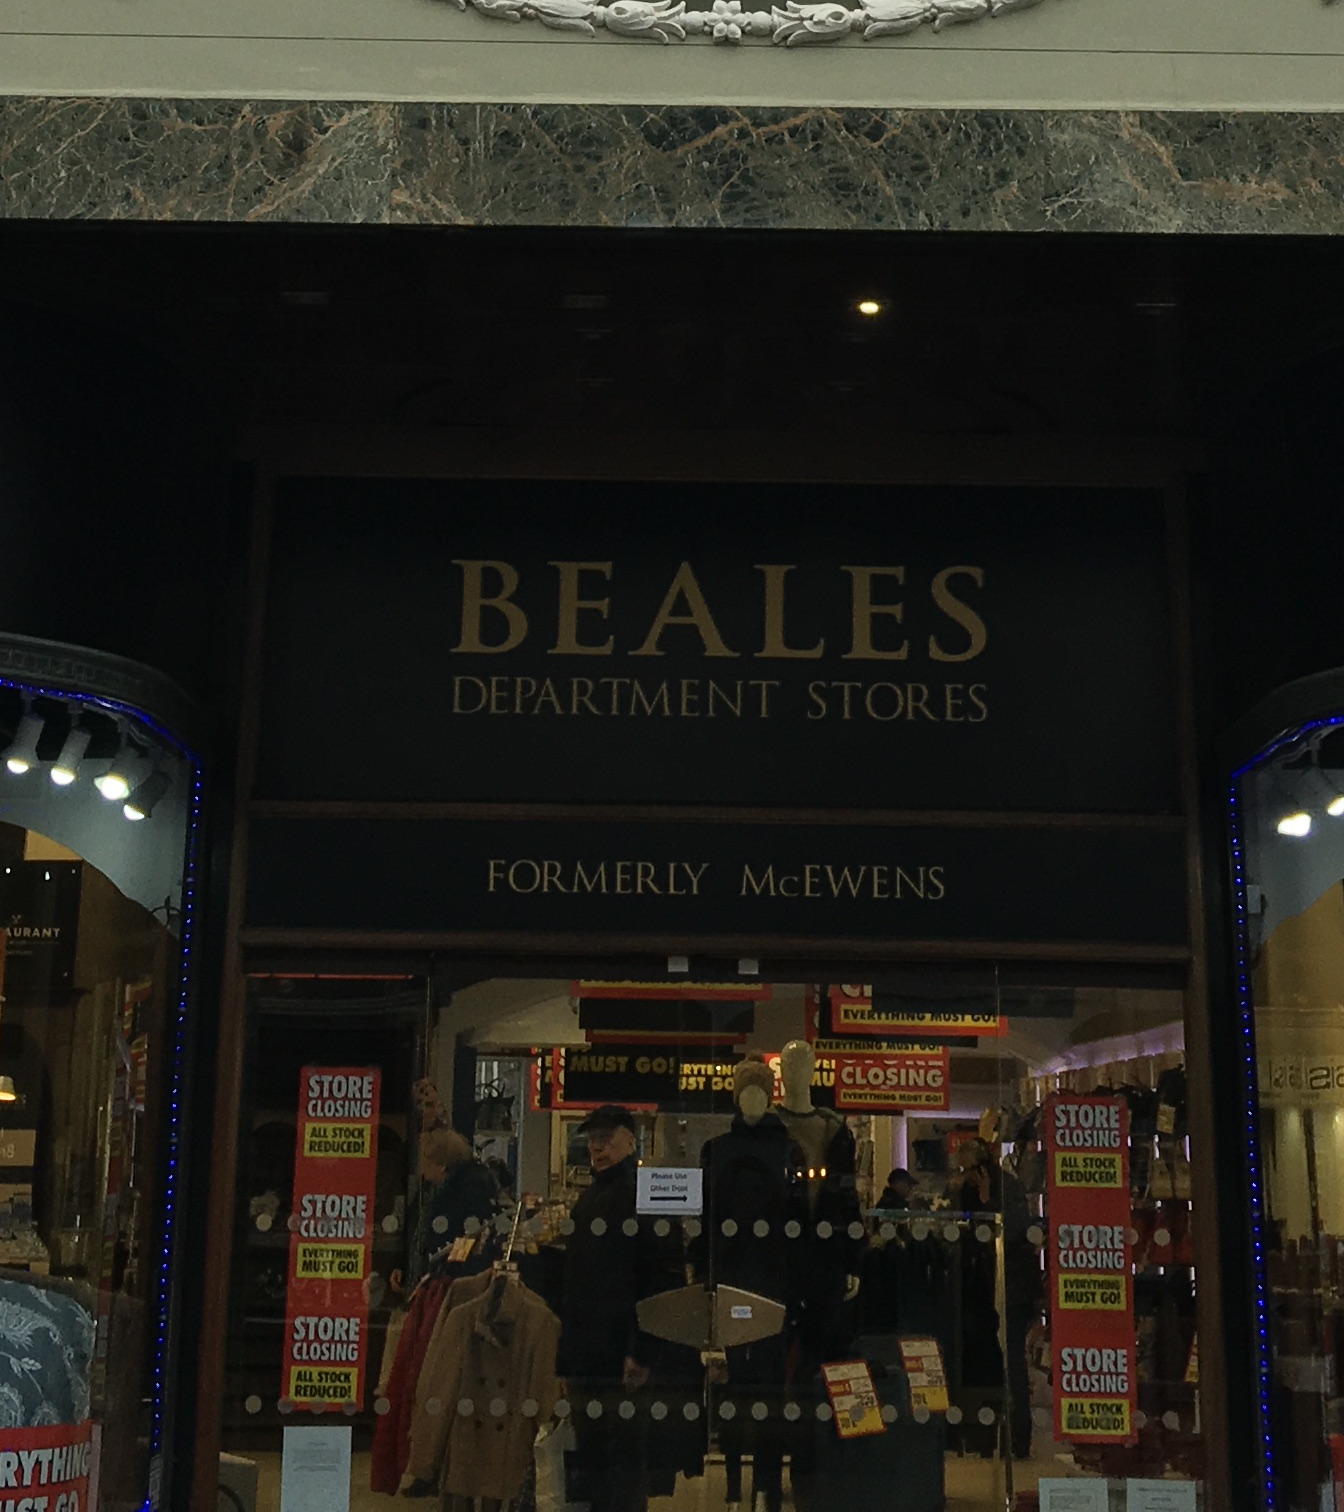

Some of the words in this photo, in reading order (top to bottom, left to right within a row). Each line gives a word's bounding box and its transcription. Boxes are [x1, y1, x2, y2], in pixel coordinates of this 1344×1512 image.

[450, 559, 988, 662] BEALES
[451, 676, 780, 719] DEPARTMENT
[807, 681, 989, 724] STORES
[487, 859, 709, 896] FORMERLY
[740, 865, 947, 900] McEWENS
[814, 1039, 882, 1051] EVERYTHING
[570, 1055, 629, 1074] MUST
[635, 1056, 675, 1075] GO!
[308, 1074, 374, 1100] STORE
[840, 1066, 945, 1088] CLOSING
[307, 1099, 372, 1119] CLOSING
[1055, 1104, 1121, 1129] STORE
[309, 1126, 329, 1139] ALL
[331, 1126, 365, 1139] STOCK
[1055, 1129, 1122, 1148] CLOSING
[309, 1140, 366, 1154] REDUCED!
[1060, 1156, 1080, 1169] ALL
[1082, 1156, 1118, 1170] STOCK
[1060, 1169, 1118, 1184] REDUCED!
[300, 1193, 368, 1219] STORE
[299, 1219, 367, 1239] CLOSING
[1057, 1224, 1126, 1250] STORE
[302, 1247, 360, 1260] EVERYTHING
[1058, 1250, 1126, 1270] CLOSING
[301, 1259, 335, 1273] MUST
[337, 1260, 359, 1274] GO!
[1063, 1278, 1122, 1290] EVERYTHING
[1064, 1290, 1098, 1304] MUST
[1100, 1291, 1122, 1305] GO!
[292, 1315, 361, 1342] STORE
[292, 1342, 360, 1362] CLOSING
[1061, 1347, 1128, 1374] STORE
[295, 1370, 314, 1383] ALL
[317, 1370, 352, 1384] STOCK
[1061, 1373, 1129, 1394] CLOSING
[294, 1384, 352, 1399] REDUCED!
[1067, 1402, 1087, 1415] ALL
[1089, 1402, 1124, 1416] STOCK
